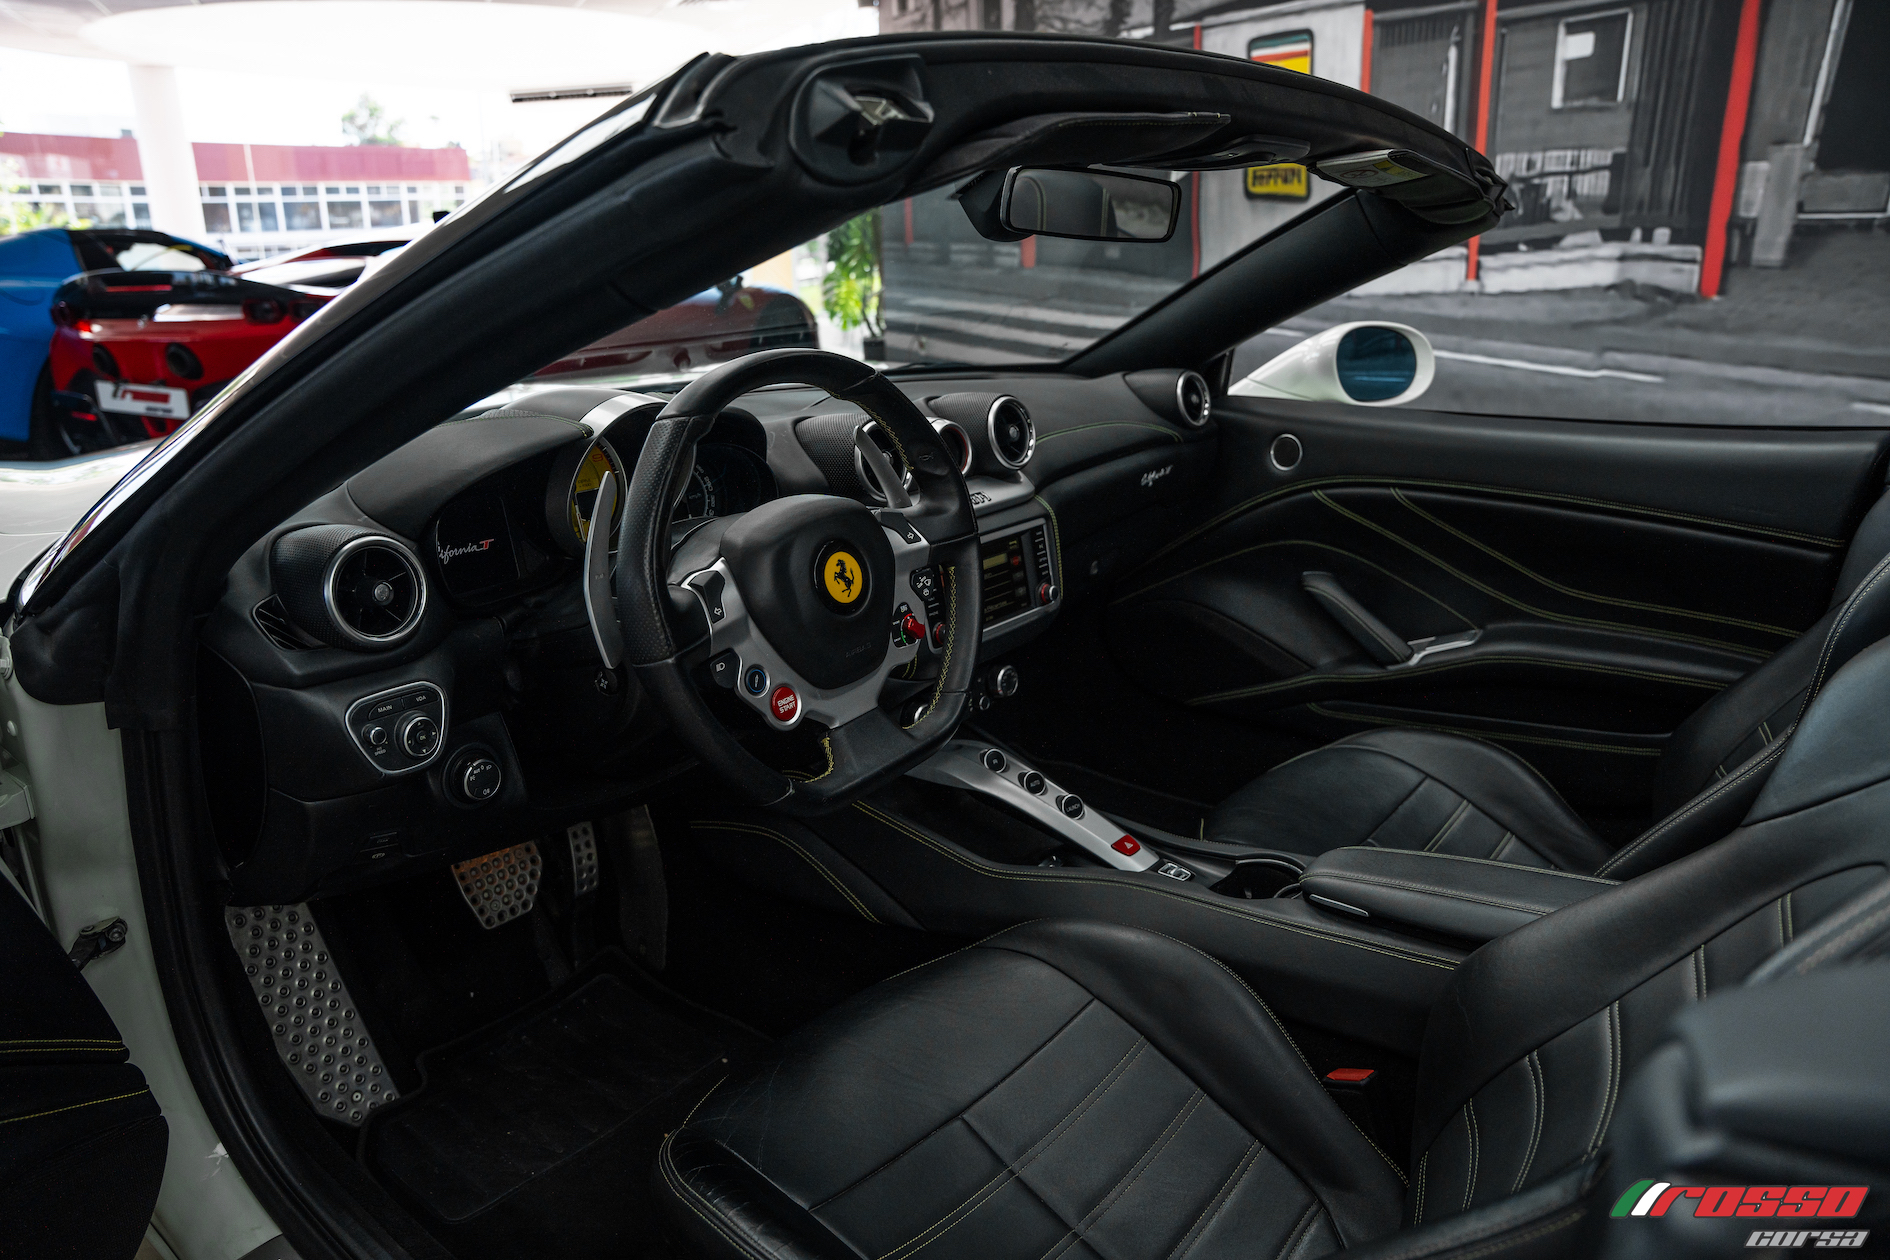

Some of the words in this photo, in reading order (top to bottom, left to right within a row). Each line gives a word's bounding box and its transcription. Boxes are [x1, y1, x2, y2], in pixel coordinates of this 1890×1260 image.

[777, 694, 795, 707] ENGINE
[377, 704, 393, 713] MAIN
[779, 701, 796, 714] START
